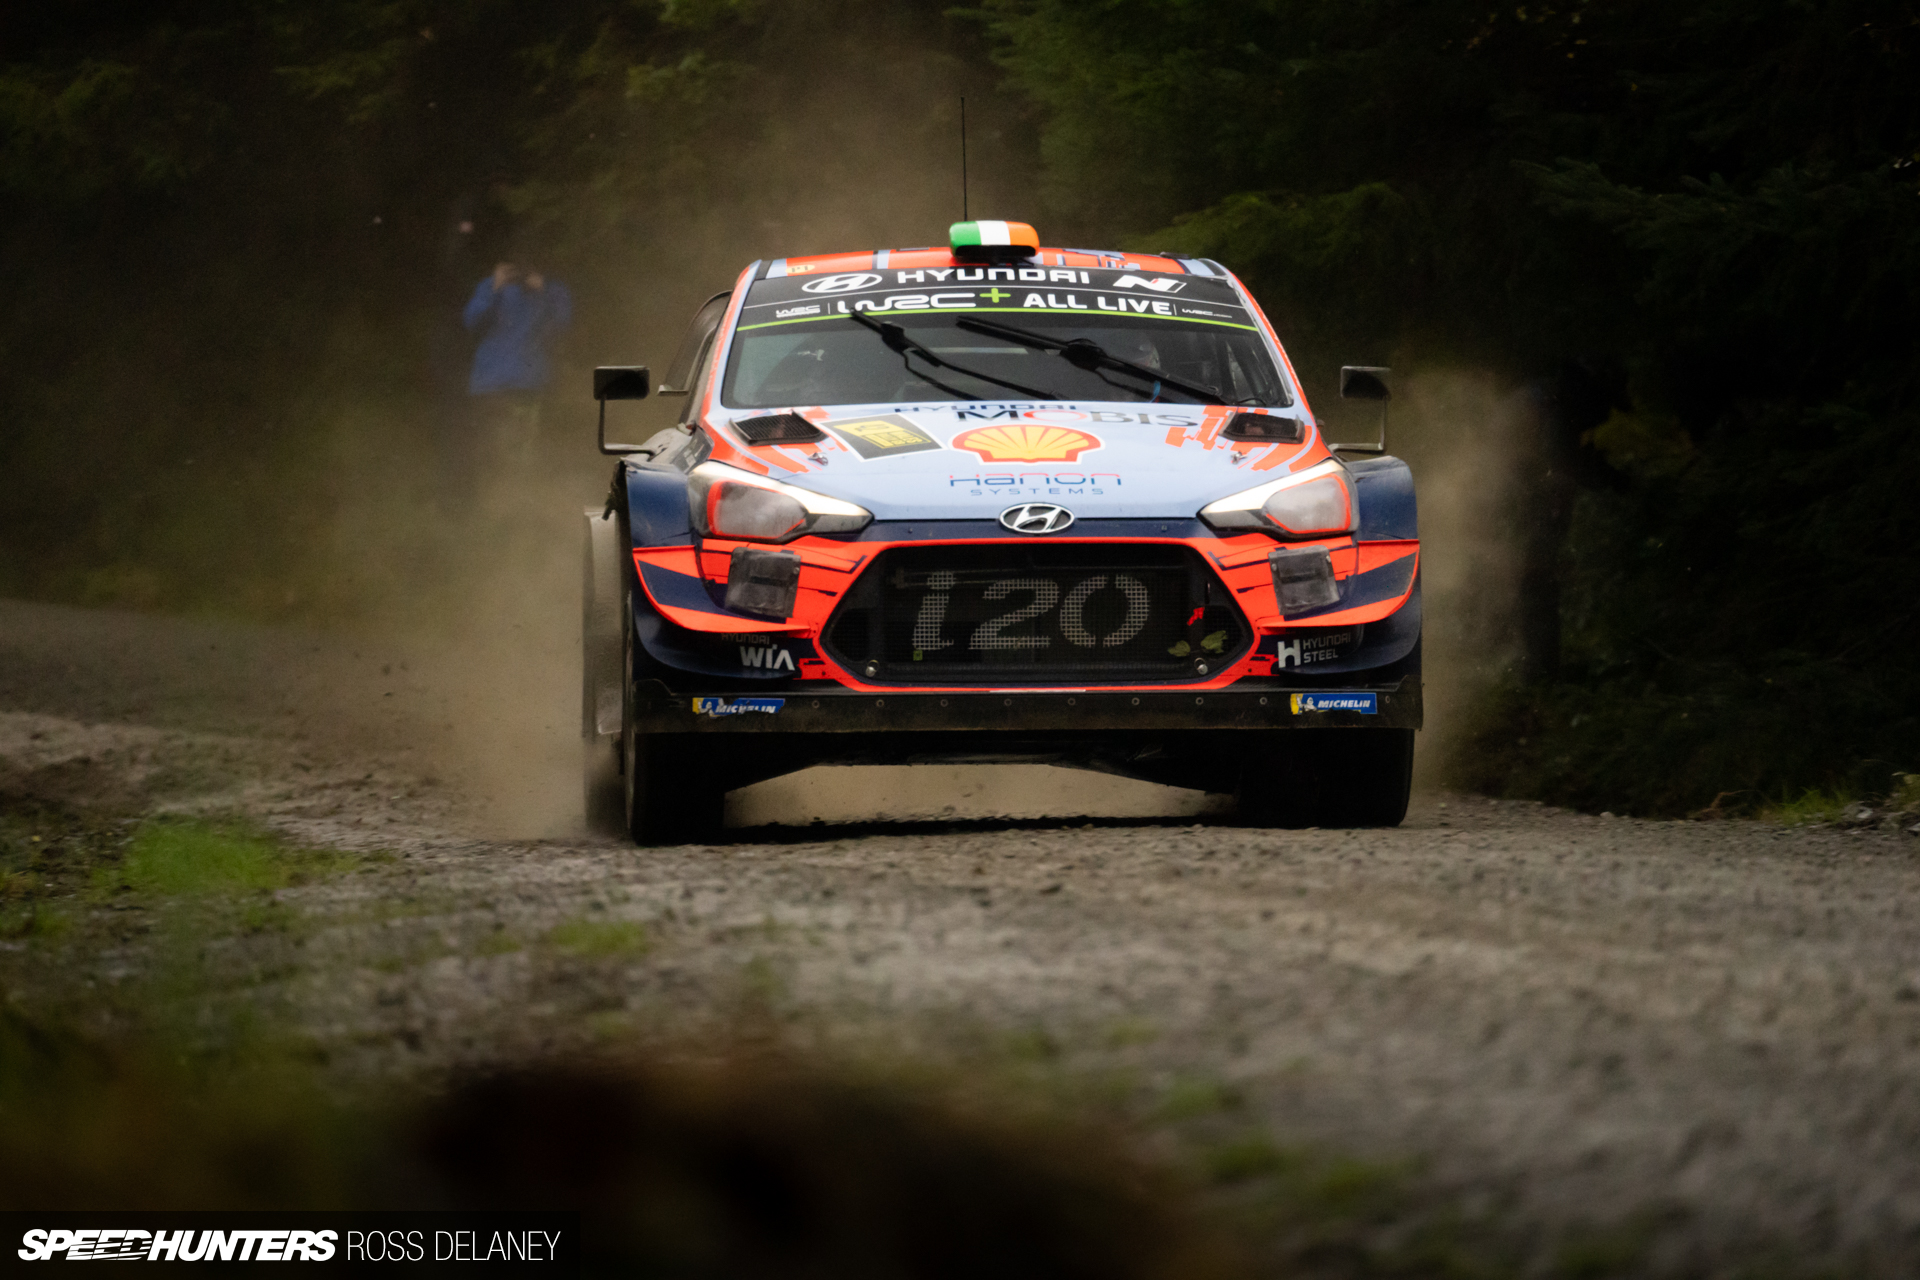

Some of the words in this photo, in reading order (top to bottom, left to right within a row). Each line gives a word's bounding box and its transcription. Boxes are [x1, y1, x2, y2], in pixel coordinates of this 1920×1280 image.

[897, 267, 1090, 284] HYUNDAI
[1023, 293, 1087, 309] ALL
[1097, 296, 1173, 316] LIVE
[957, 409, 1198, 427] MOBIS
[970, 488, 1104, 496] SYSTEMS
[721, 633, 770, 645] HYUNDAI
[1303, 633, 1351, 649] HYUNDAI
[1304, 649, 1338, 663] STEEL
[1318, 700, 1371, 708] MICHELIN
